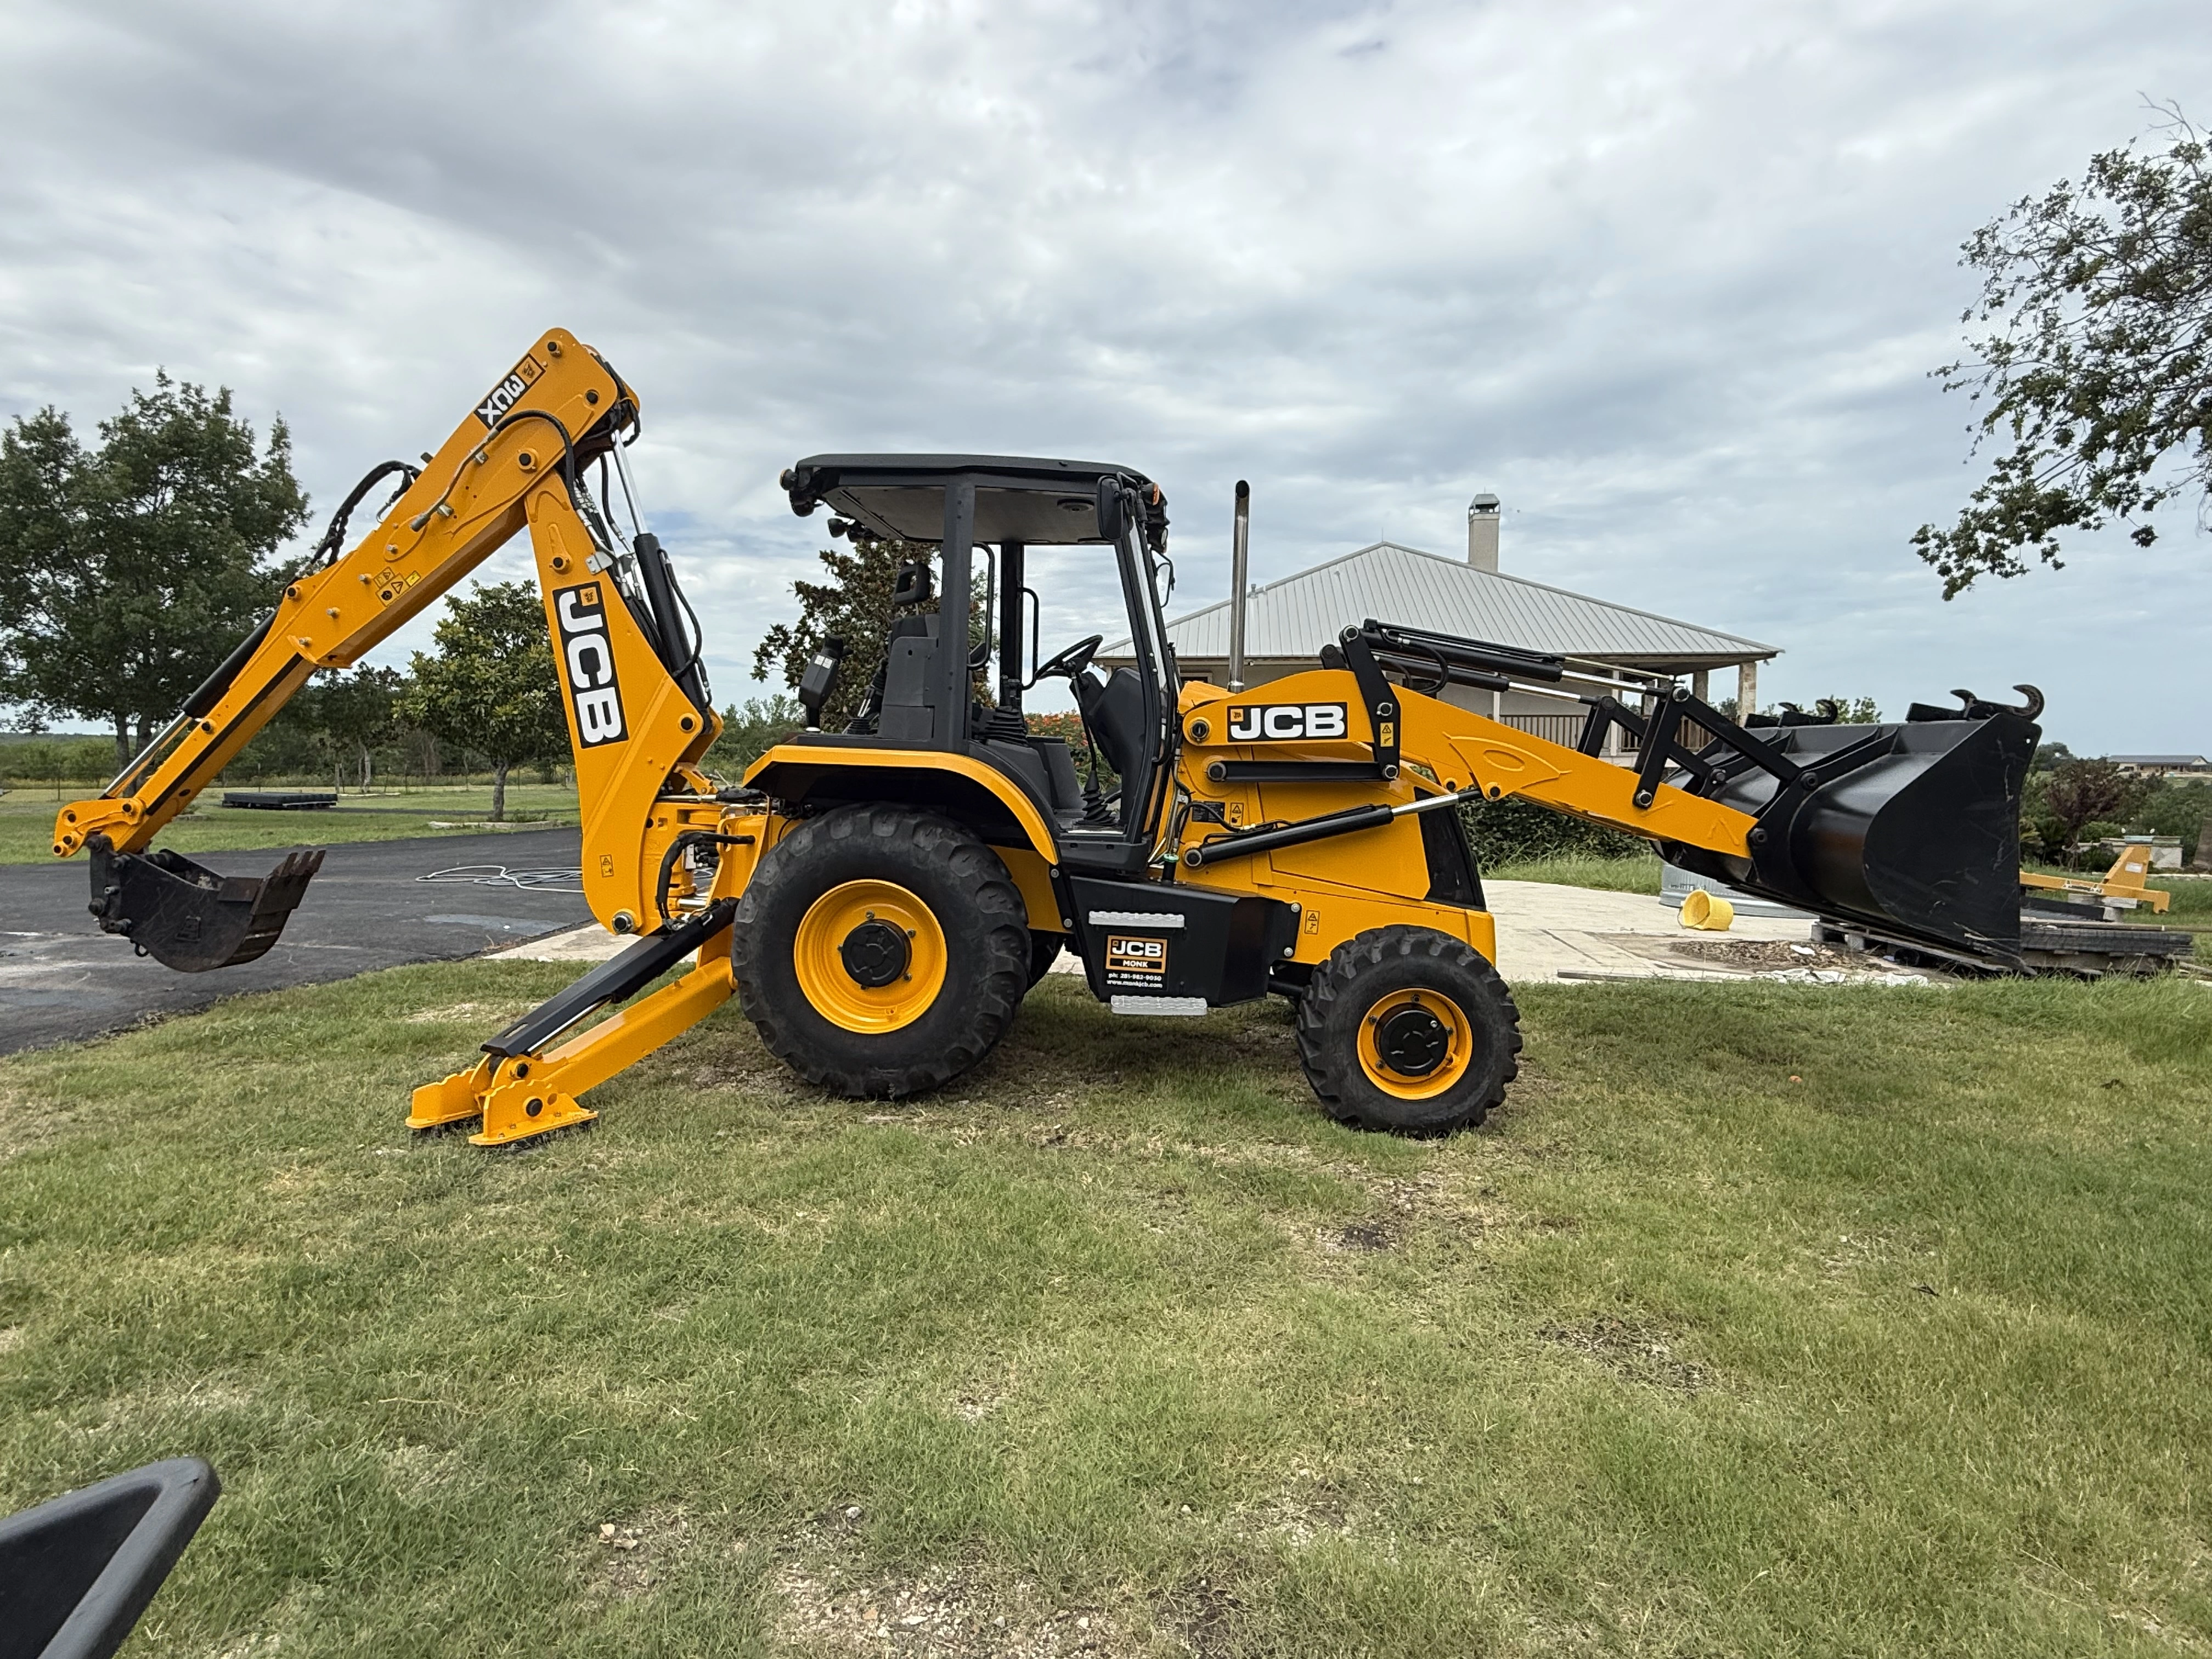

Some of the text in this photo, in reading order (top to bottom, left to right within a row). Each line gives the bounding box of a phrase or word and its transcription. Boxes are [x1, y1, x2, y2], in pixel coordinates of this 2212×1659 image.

[559, 590, 622, 743] JCB
[1230, 706, 1345, 740] JCB
[1112, 940, 1161, 957] JCB
[1122, 960, 1148, 968] MONK
